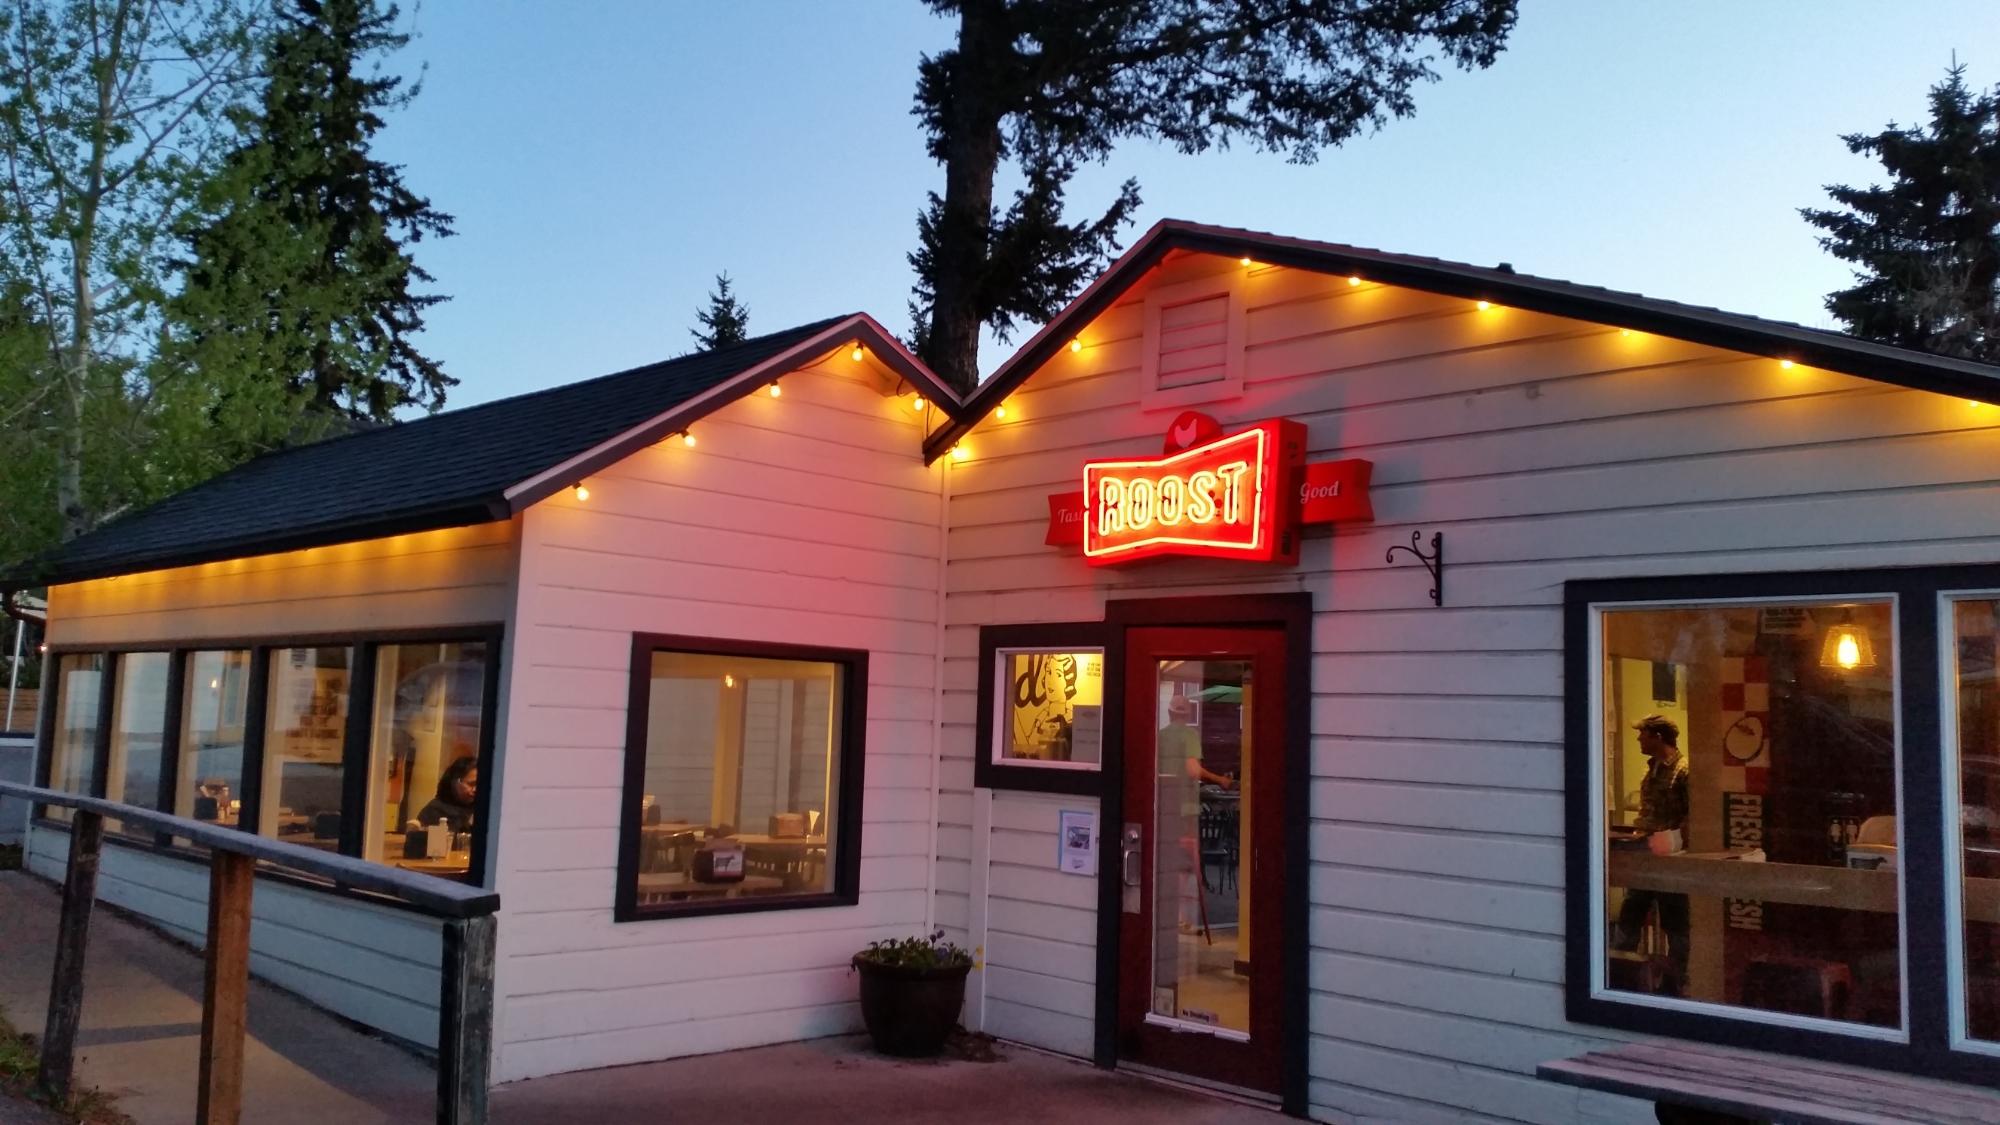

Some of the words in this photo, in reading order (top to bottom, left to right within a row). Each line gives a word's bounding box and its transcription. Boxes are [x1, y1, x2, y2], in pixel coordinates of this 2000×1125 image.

[1098, 460, 1248, 537] ROOST
[1300, 480, 1339, 504] Good
[1728, 792, 1763, 850] FRESH
